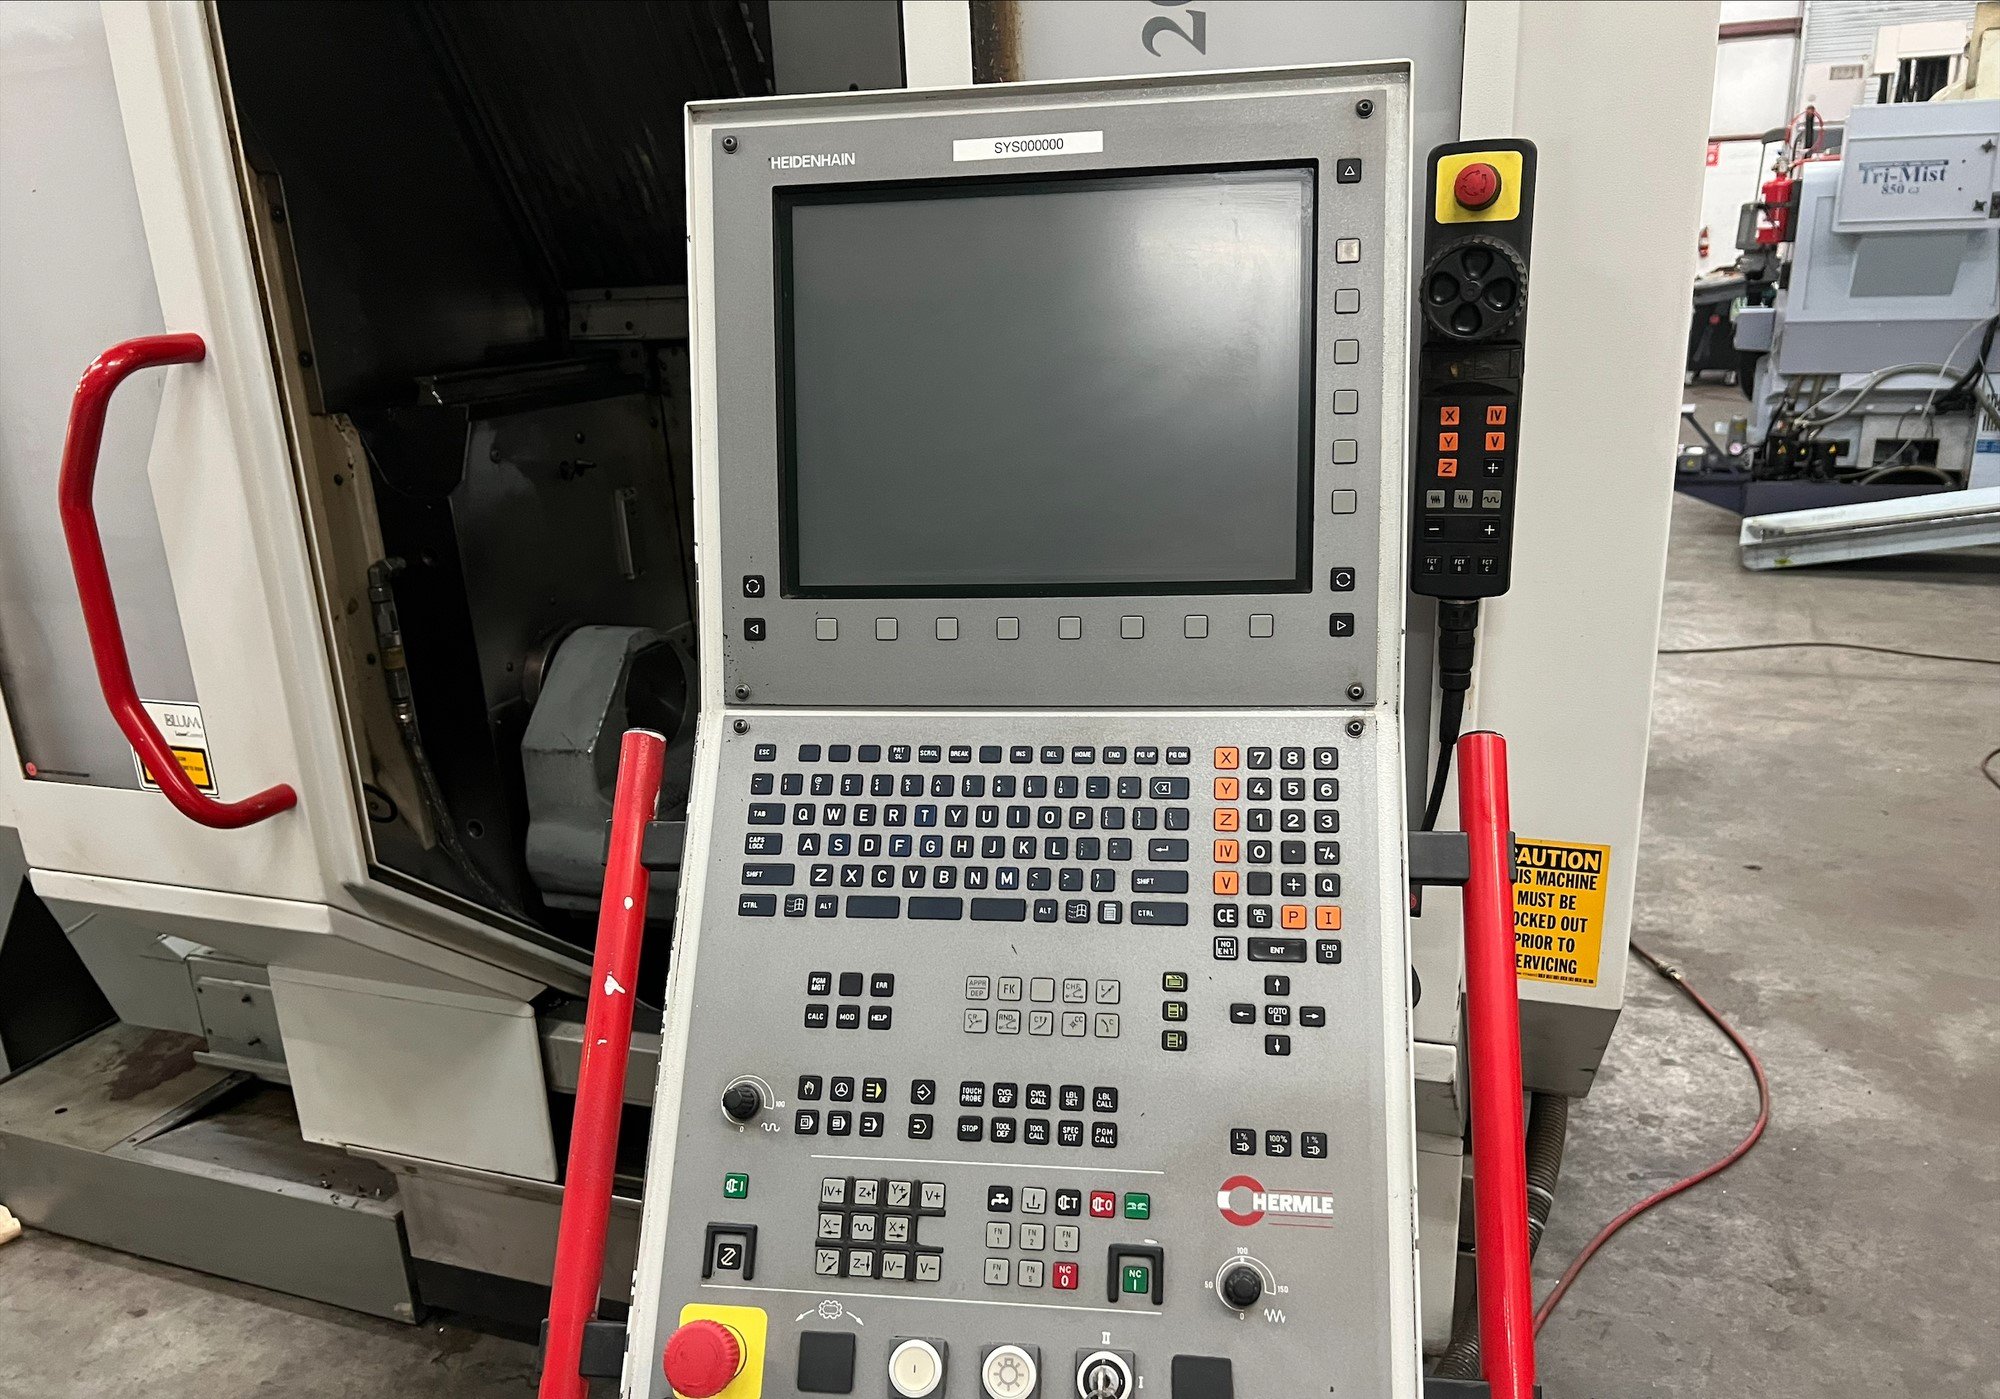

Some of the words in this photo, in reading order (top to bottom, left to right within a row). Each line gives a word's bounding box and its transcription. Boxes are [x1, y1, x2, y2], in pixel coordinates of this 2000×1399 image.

[1142, 0, 1206, 57] 2
[994, 138, 1064, 154] SYS000000
[771, 153, 855, 169] HEIDENHAIN
[1859, 164, 1945, 184] Tri-Mist
[1881, 184, 1904, 194] 850
[1446, 411, 1454, 422] X
[1490, 410, 1502, 421] IV
[1445, 437, 1453, 447] Y
[1491, 437, 1499, 447] V
[1442, 463, 1452, 473] Z
[164, 714, 201, 729] BLUM
[1222, 752, 1231, 763] X
[1253, 752, 1265, 764] 7
[1287, 752, 1298, 764] 8
[1320, 752, 1332, 764] 9
[1221, 783, 1232, 794] Y
[1253, 783, 1265, 795] 4
[1288, 782, 1299, 795] 5
[1321, 784, 1332, 796] 6
[754, 810, 766, 818] TAB
[798, 809, 808, 821] Q
[827, 809, 841, 820] W
[860, 809, 868, 821] E
[889, 810, 898, 821] R
[921, 810, 929, 821] T
[951, 810, 961, 822] Y
[982, 811, 992, 822] U
[1016, 811, 1019, 822] I
[1045, 811, 1054, 824] O
[1076, 812, 1086, 824] P
[1220, 814, 1232, 825] Z
[1256, 814, 1263, 826] 1
[1287, 814, 1299, 827] 2
[1321, 815, 1333, 828] 3
[803, 839, 813, 851] A
[834, 839, 843, 850] S
[864, 839, 874, 851] D
[895, 840, 904, 851] F
[926, 841, 935, 853] G
[957, 841, 967, 852] H
[989, 841, 996, 853] J
[1020, 842, 1029, 854] K
[1052, 842, 1060, 855] L
[1220, 845, 1232, 857] IV
[1515, 847, 1599, 871] AUTION
[815, 869, 827, 881] Z
[846, 870, 857, 882] X
[878, 870, 887, 882] C
[909, 871, 918, 883] V
[940, 871, 949, 884] B
[970, 872, 980, 885] N
[1001, 872, 1013, 884] M
[1536, 871, 1598, 890] MACHINE
[1222, 877, 1230, 889] V
[1322, 879, 1333, 891] Q
[1518, 891, 1555, 907] MUST
[1560, 895, 1576, 910] BE
[1217, 909, 1234, 922] CE
[1289, 911, 1298, 923] P
[1326, 912, 1331, 924] I
[1514, 911, 1556, 929] OCKED
[1561, 916, 1588, 932] OUT
[1515, 933, 1553, 950] PRIOR
[1558, 937, 1575, 953] TO
[1516, 954, 1577, 974] ERVICING
[1003, 984, 1015, 994] FK
[1268, 1007, 1287, 1015] GOTO
[1030, 1090, 1046, 1098] CYCL
[1065, 1091, 1078, 1099] LBL
[1096, 1100, 1113, 1108] CALL
[996, 1123, 1011, 1131] TOOL
[1063, 1126, 1079, 1134] SPEC
[1096, 1128, 1112, 1136] PGM
[1029, 1132, 1044, 1140] CALL
[1095, 1135, 1113, 1144] CALL
[824, 1186, 842, 1196] IV+
[925, 1191, 941, 1200] V+
[1253, 1193, 1333, 1214] HERMLE
[920, 1263, 936, 1273] V-
[1059, 1266, 1071, 1274] NC
[1129, 1270, 1141, 1278] NC
